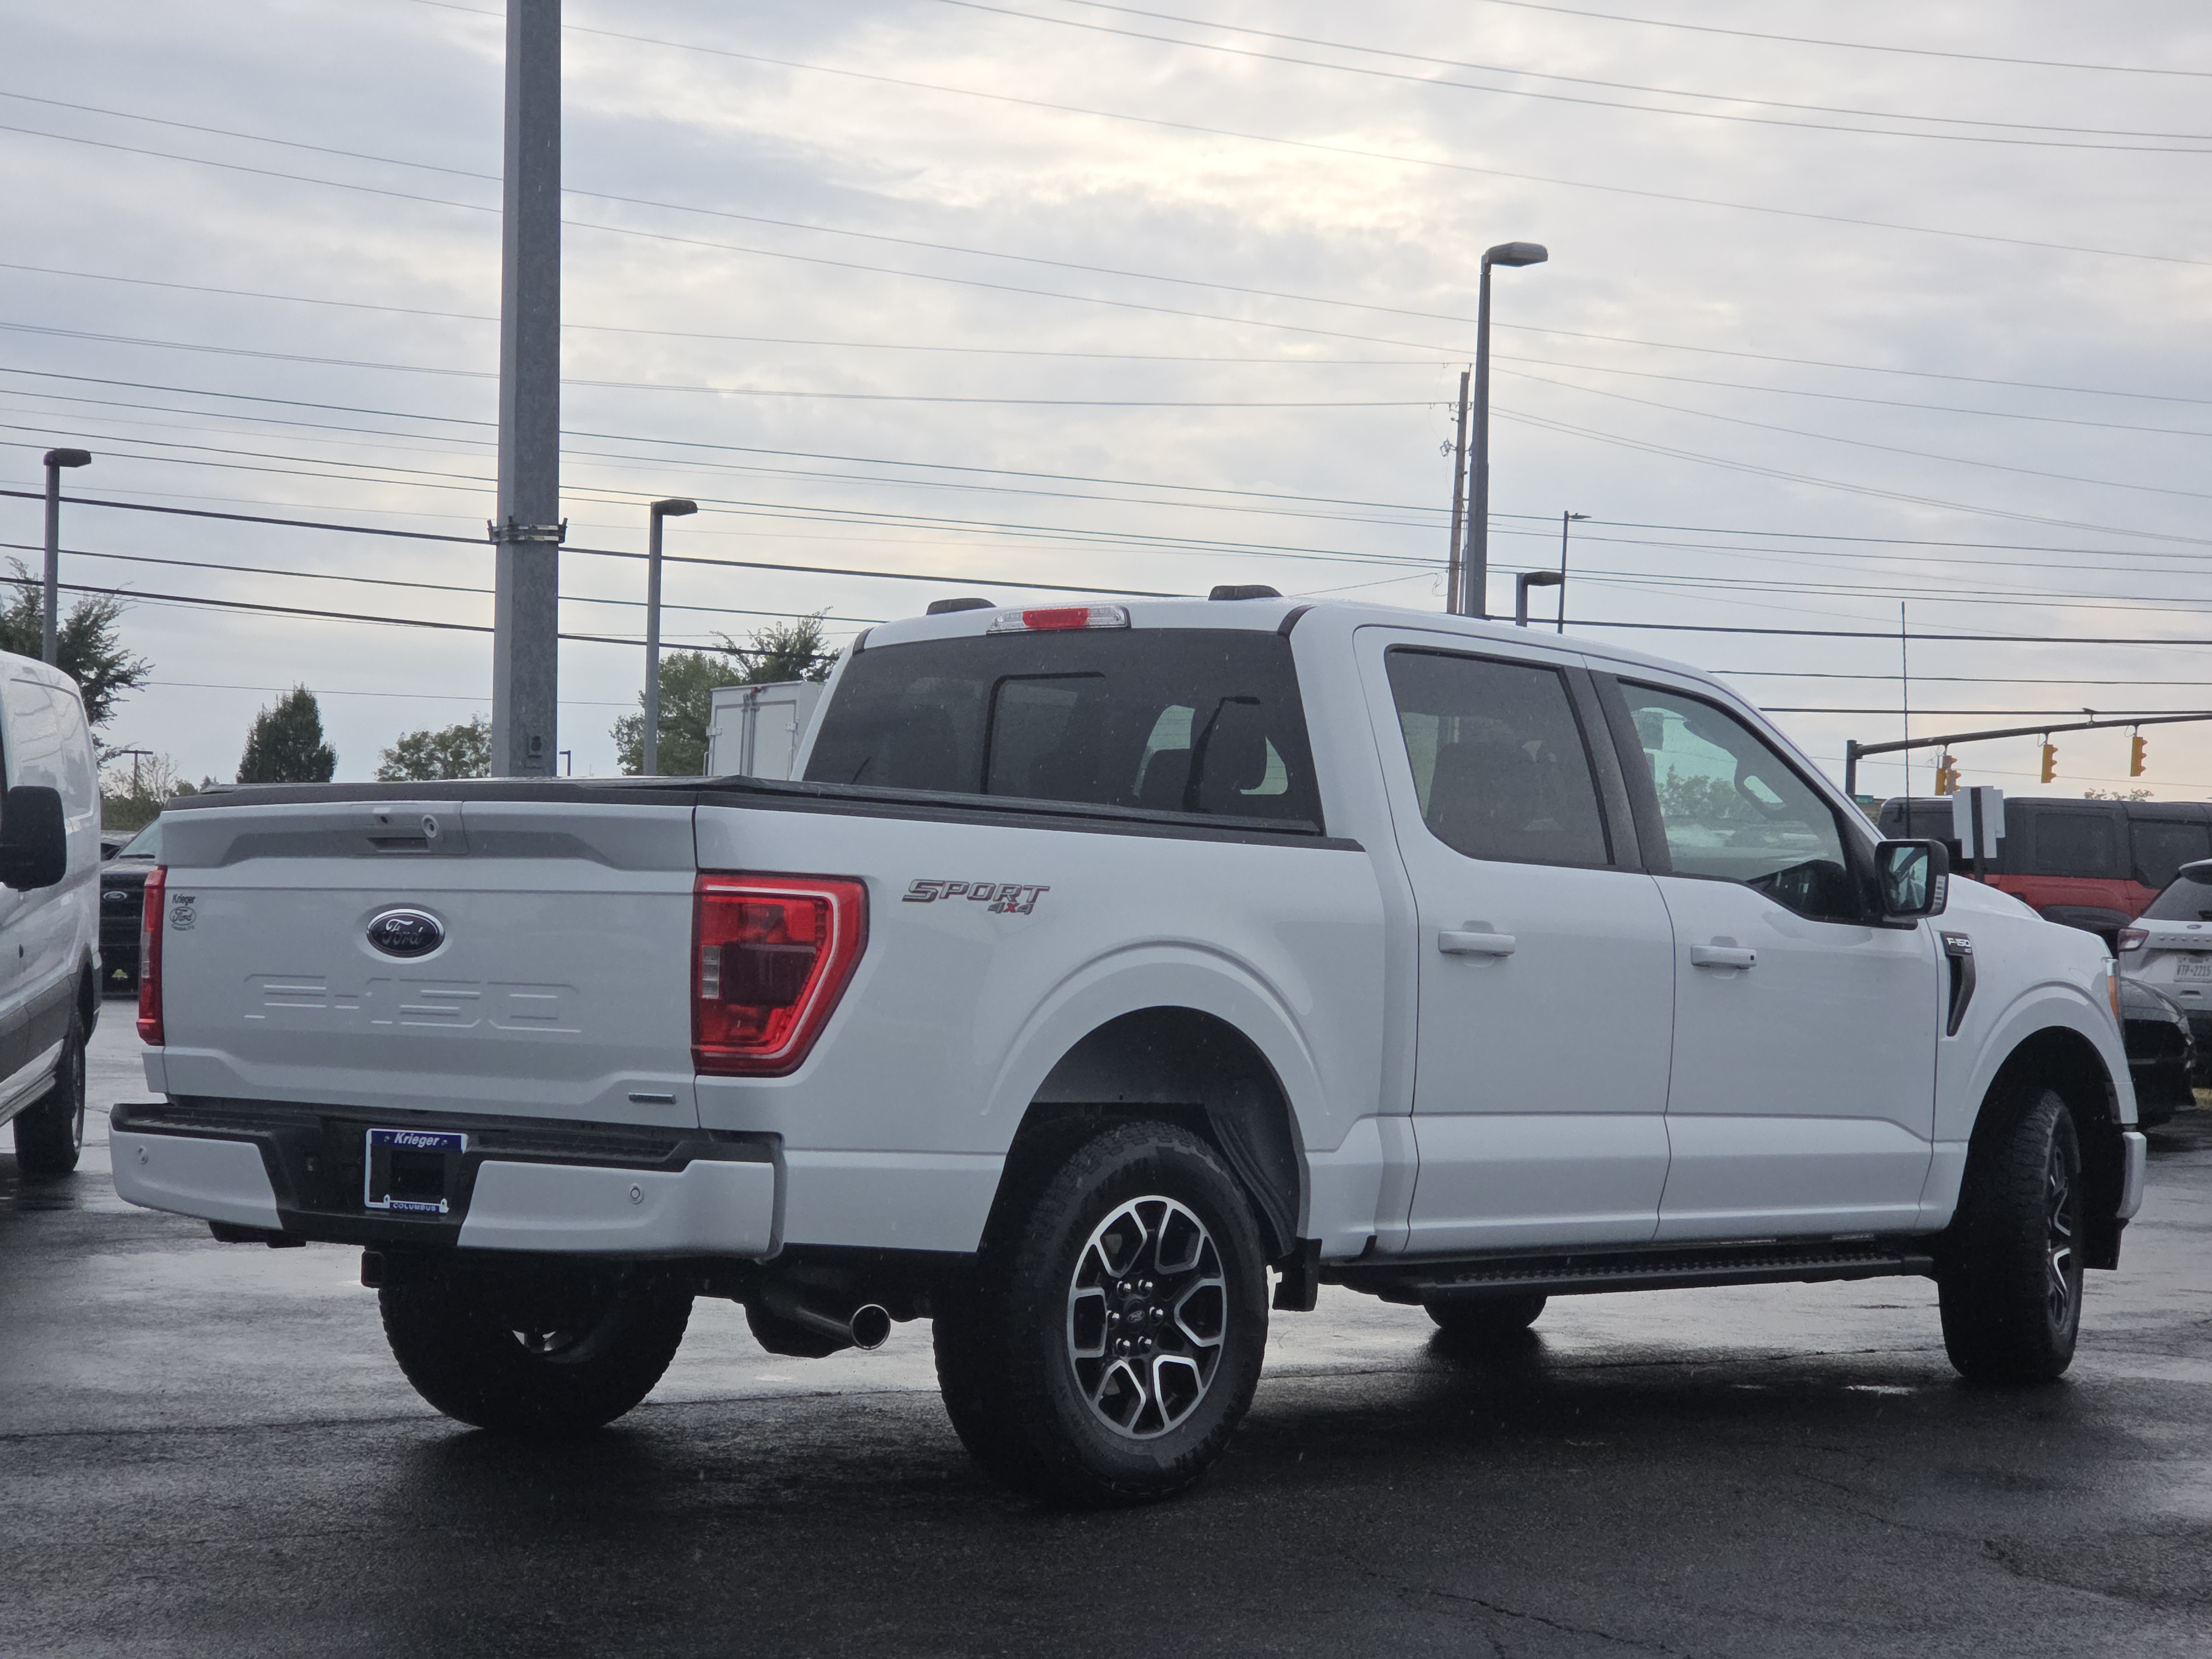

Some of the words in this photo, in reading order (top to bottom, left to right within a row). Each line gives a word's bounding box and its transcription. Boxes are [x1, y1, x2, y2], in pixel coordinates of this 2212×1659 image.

[901, 878, 1051, 904] SPORT
[172, 893, 196, 906] Krieger
[172, 909, 193, 922] Ford
[382, 918, 424, 946] Ford
[1947, 937, 1971, 947] F-150
[393, 1131, 441, 1148] Krieger
[392, 1203, 436, 1212] COLUMBUS
